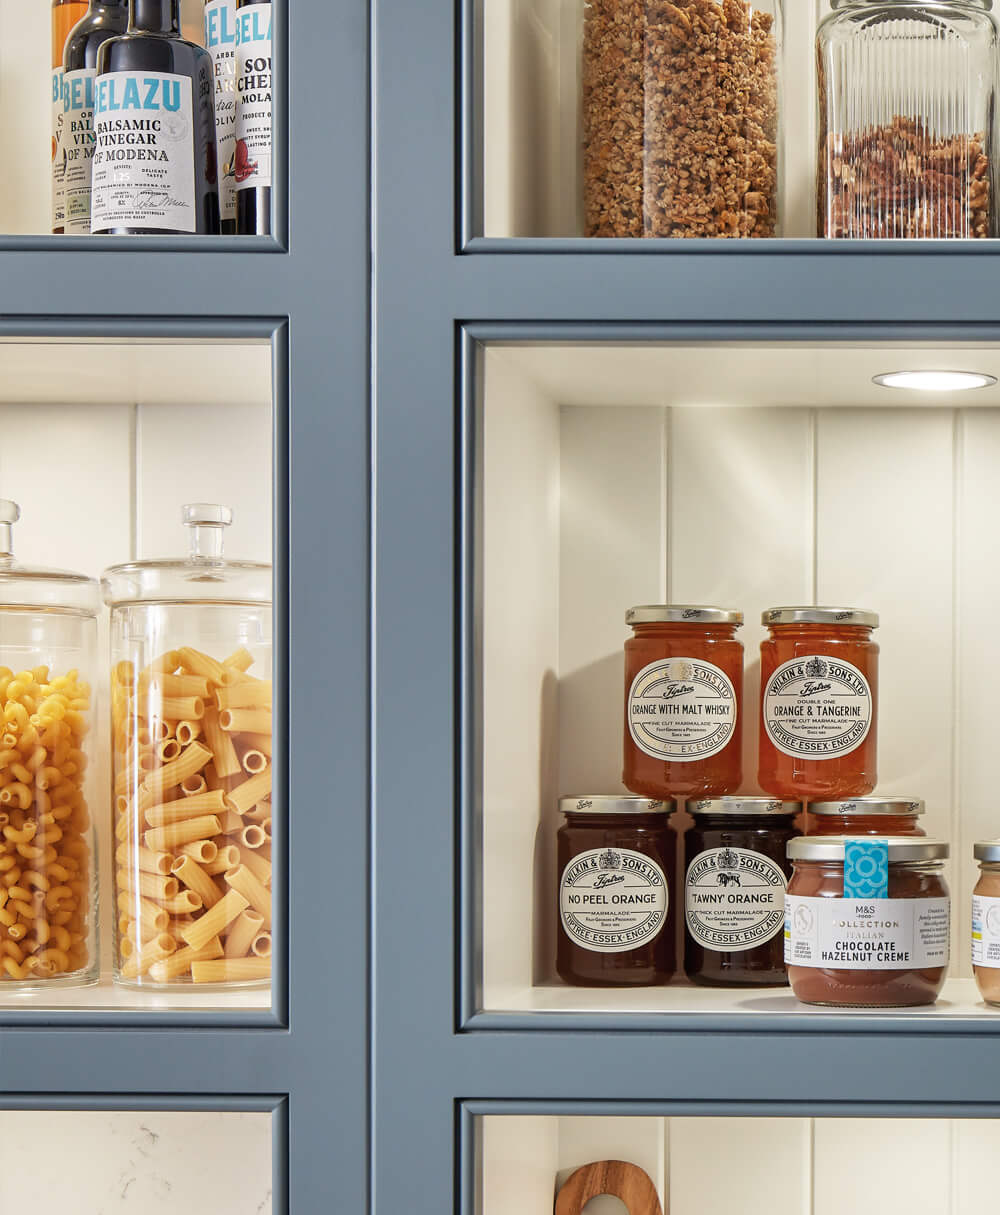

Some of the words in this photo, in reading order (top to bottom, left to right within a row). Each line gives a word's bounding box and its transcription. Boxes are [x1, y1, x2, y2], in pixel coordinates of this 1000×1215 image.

[94, 78, 181, 117] BELAZU
[97, 120, 161, 134] BALSAMIC
[99, 133, 157, 147] VINEGAR
[94, 152, 104, 165] OF
[106, 149, 169, 162] MODENA
[693, 669, 717, 685] SONS
[771, 669, 795, 693] WILKIN
[798, 667, 804, 675] &
[829, 667, 853, 682] SONS
[852, 678, 864, 695] LTD
[632, 704, 657, 715] ORANGE
[659, 704, 680, 714] WITH
[682, 704, 703, 714] MALT
[704, 704, 730, 715] WHISKY
[774, 706, 804, 716] ORANGE
[807, 706, 813, 716] &
[817, 706, 861, 717] TANGERINE
[566, 860, 589, 885] WILKIN
[591, 859, 598, 867] &
[622, 859, 646, 873] SONS
[648, 870, 660, 885] LTD
[689, 860, 708, 883] WILKIN
[710, 858, 715, 866] &
[740, 858, 765, 874] SONS
[765, 869, 779, 885] LTD
[568, 894, 581, 904] NO
[583, 894, 609, 904] PEEL
[612, 893, 657, 904] ORANGE
[727, 893, 774, 904] ORANGE
[855, 906, 875, 914] M&S
[846, 931, 884, 939] ITALIAN
[835, 941, 896, 951] CHOCOLATE
[821, 952, 873, 962] HAZELNUT
[877, 952, 910, 962] CREME
